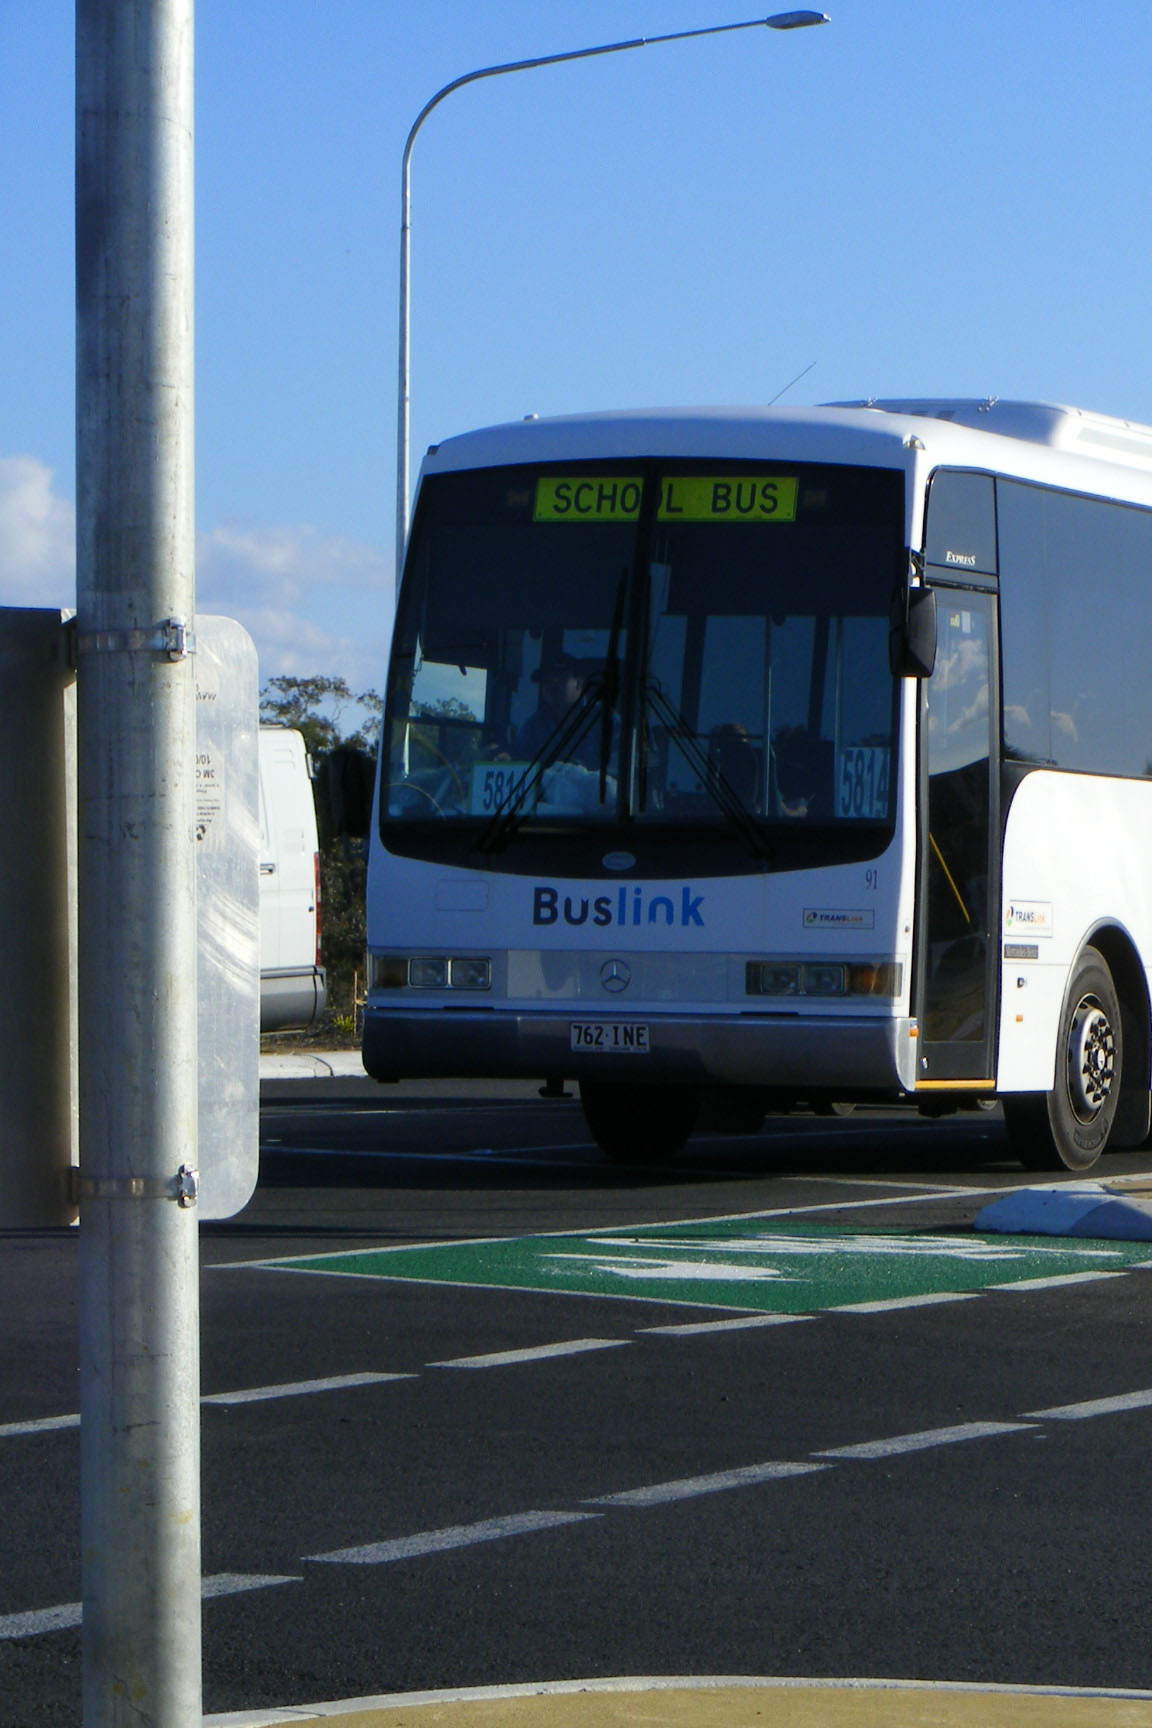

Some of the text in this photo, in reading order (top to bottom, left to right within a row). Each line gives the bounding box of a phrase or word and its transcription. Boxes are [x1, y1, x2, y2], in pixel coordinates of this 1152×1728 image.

[553, 482, 779, 514] SCHOL BUS
[865, 868, 878, 890] 91
[532, 886, 705, 926] Buslink
